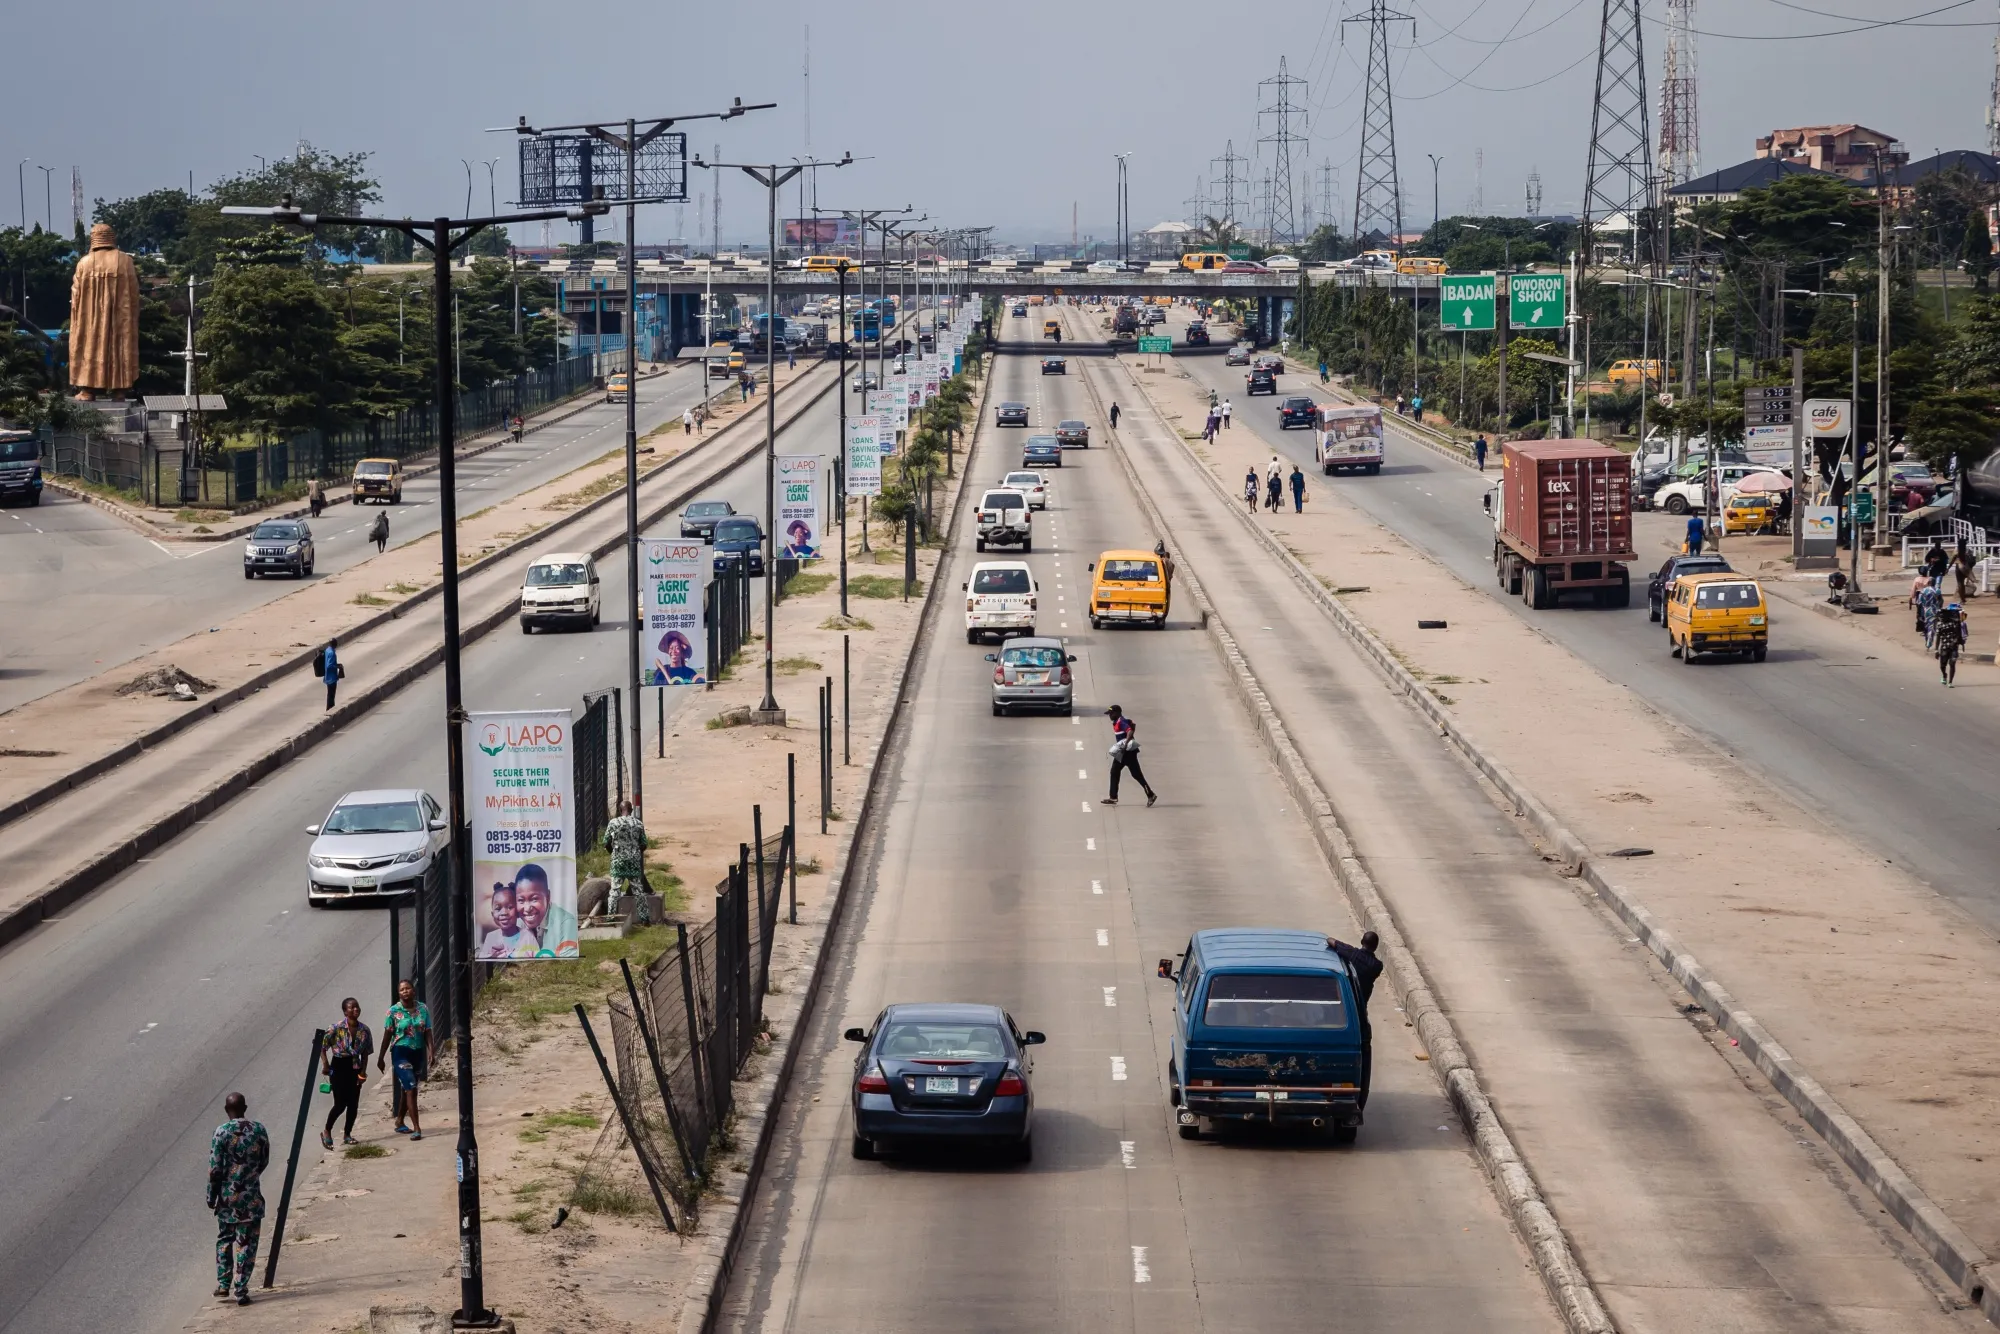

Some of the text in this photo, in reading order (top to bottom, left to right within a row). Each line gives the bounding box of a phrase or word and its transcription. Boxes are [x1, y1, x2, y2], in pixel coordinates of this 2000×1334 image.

[1512, 278, 1561, 292] OWORON
[1442, 285, 1493, 301] IBADAN
[1518, 290, 1556, 303] SHOKI
[1766, 402, 1784, 410] 655
[1812, 406, 1838, 417] café
[1765, 414, 1784, 422] 210
[852, 454, 874, 462] SOCIAL
[792, 460, 816, 470] LAPO
[786, 484, 810, 493] AGRIC
[1548, 479, 1570, 493] tex
[786, 494, 808, 502] LOAN
[666, 546, 698, 559] LAPO
[657, 580, 690, 592] AGRIC
[658, 593, 686, 604] LOAN
[508, 724, 562, 746] LAPO
[493, 768, 549, 777] SECURE THEIR
[496, 778, 549, 787] FUTURE WITH
[486, 794, 544, 812] MyPikin & I
[497, 820, 517, 828] Please
[486, 830, 562, 841] 0813-984-0230
[488, 842, 560, 854] 0815-037-8877
